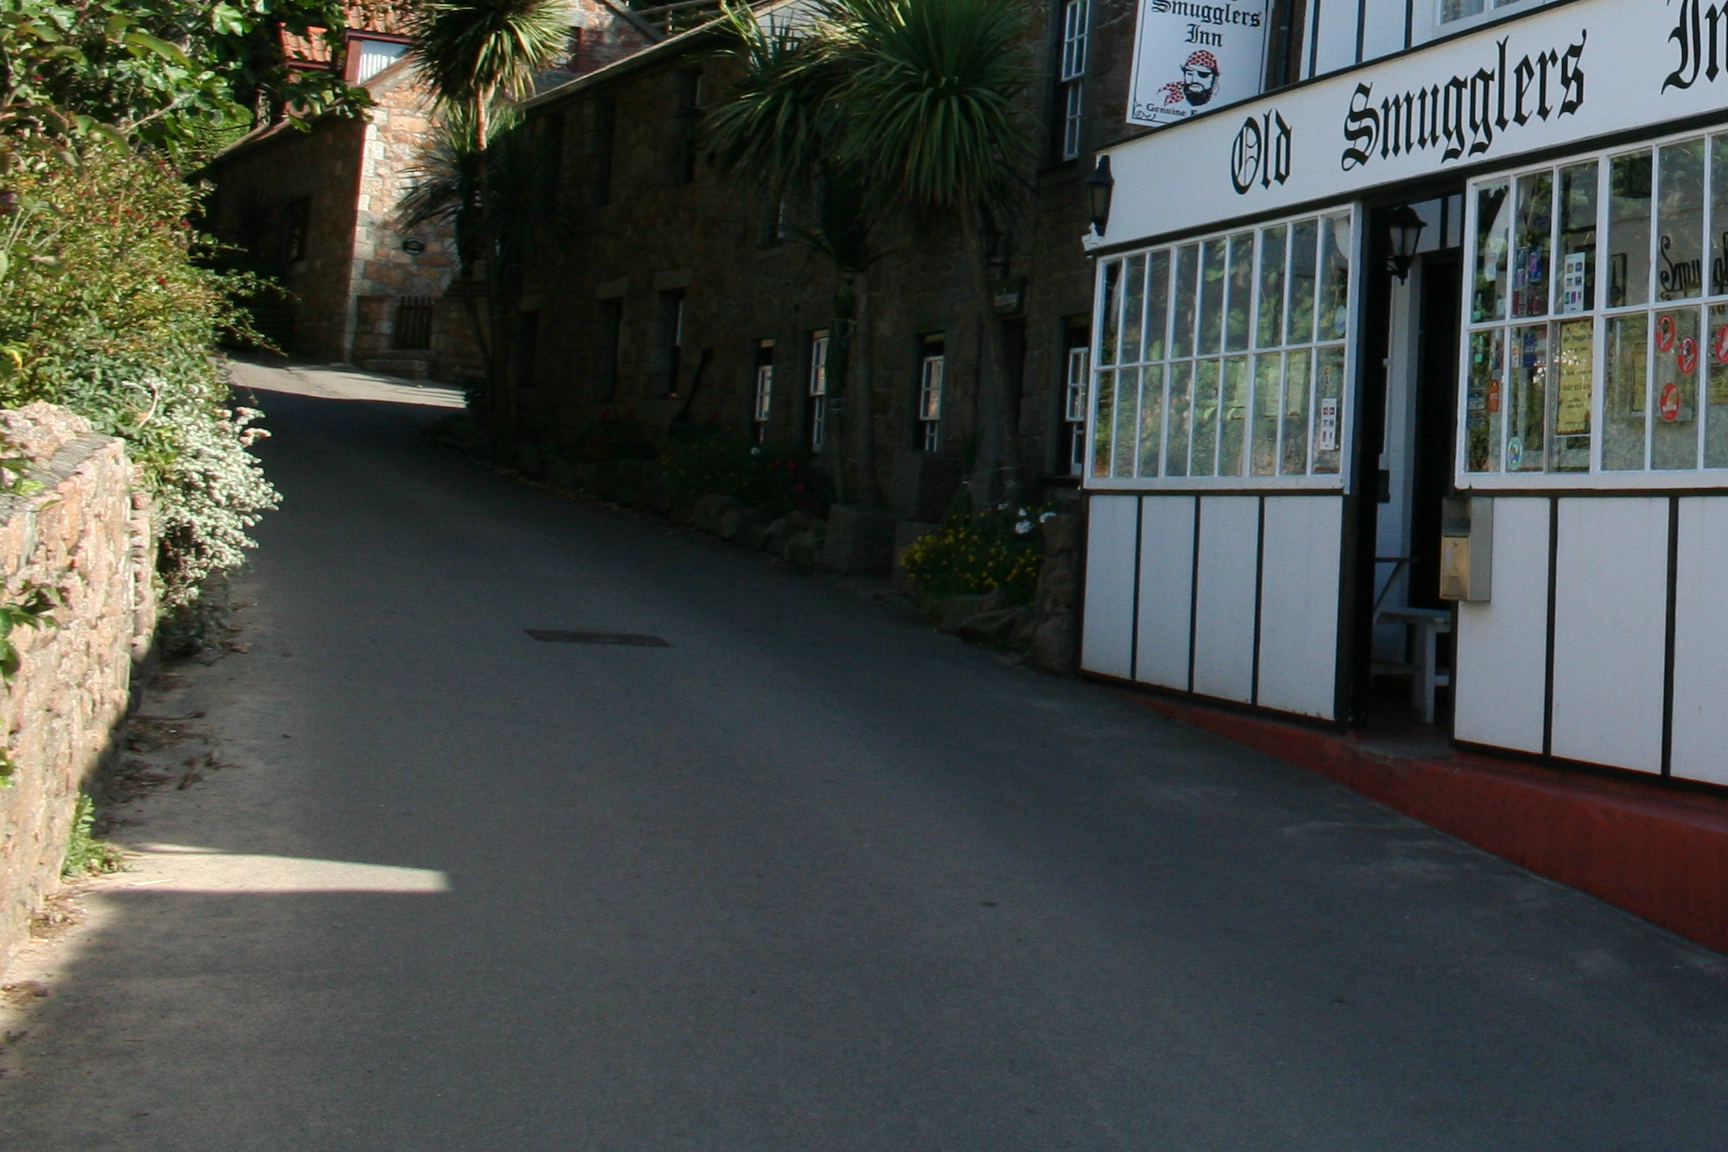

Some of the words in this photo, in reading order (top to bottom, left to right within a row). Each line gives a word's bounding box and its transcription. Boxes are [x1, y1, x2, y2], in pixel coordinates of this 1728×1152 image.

[1184, 23, 1224, 47] Inn
[1146, 103, 1187, 117] Genuine
[1230, 108, 1293, 195] Old
[1341, 28, 1588, 172] Smugglers
